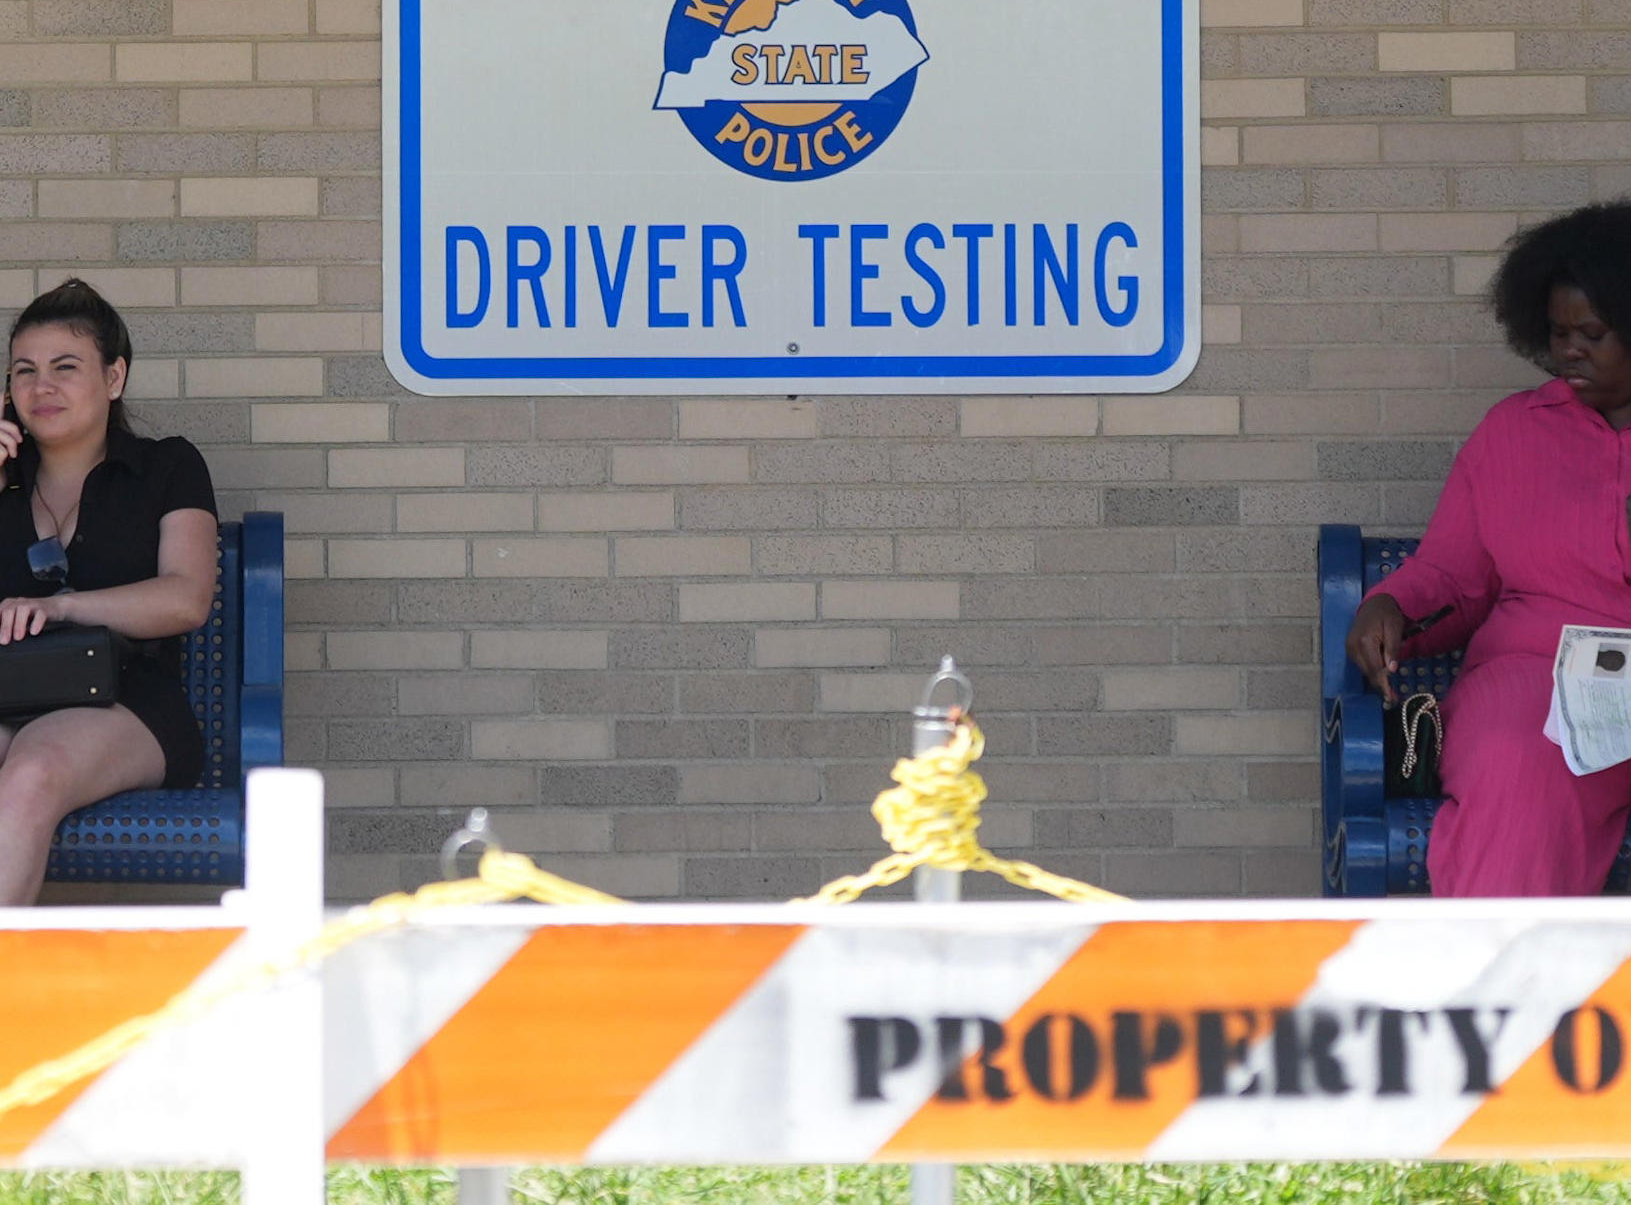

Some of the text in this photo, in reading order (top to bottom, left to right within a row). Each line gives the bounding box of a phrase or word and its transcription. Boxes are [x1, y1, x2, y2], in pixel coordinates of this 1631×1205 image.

[730, 43, 871, 86] STATE
[714, 110, 874, 173] POLICE
[445, 221, 1140, 329] DRIVER TESTING
[846, 1002, 1512, 1104] PROPERTY
